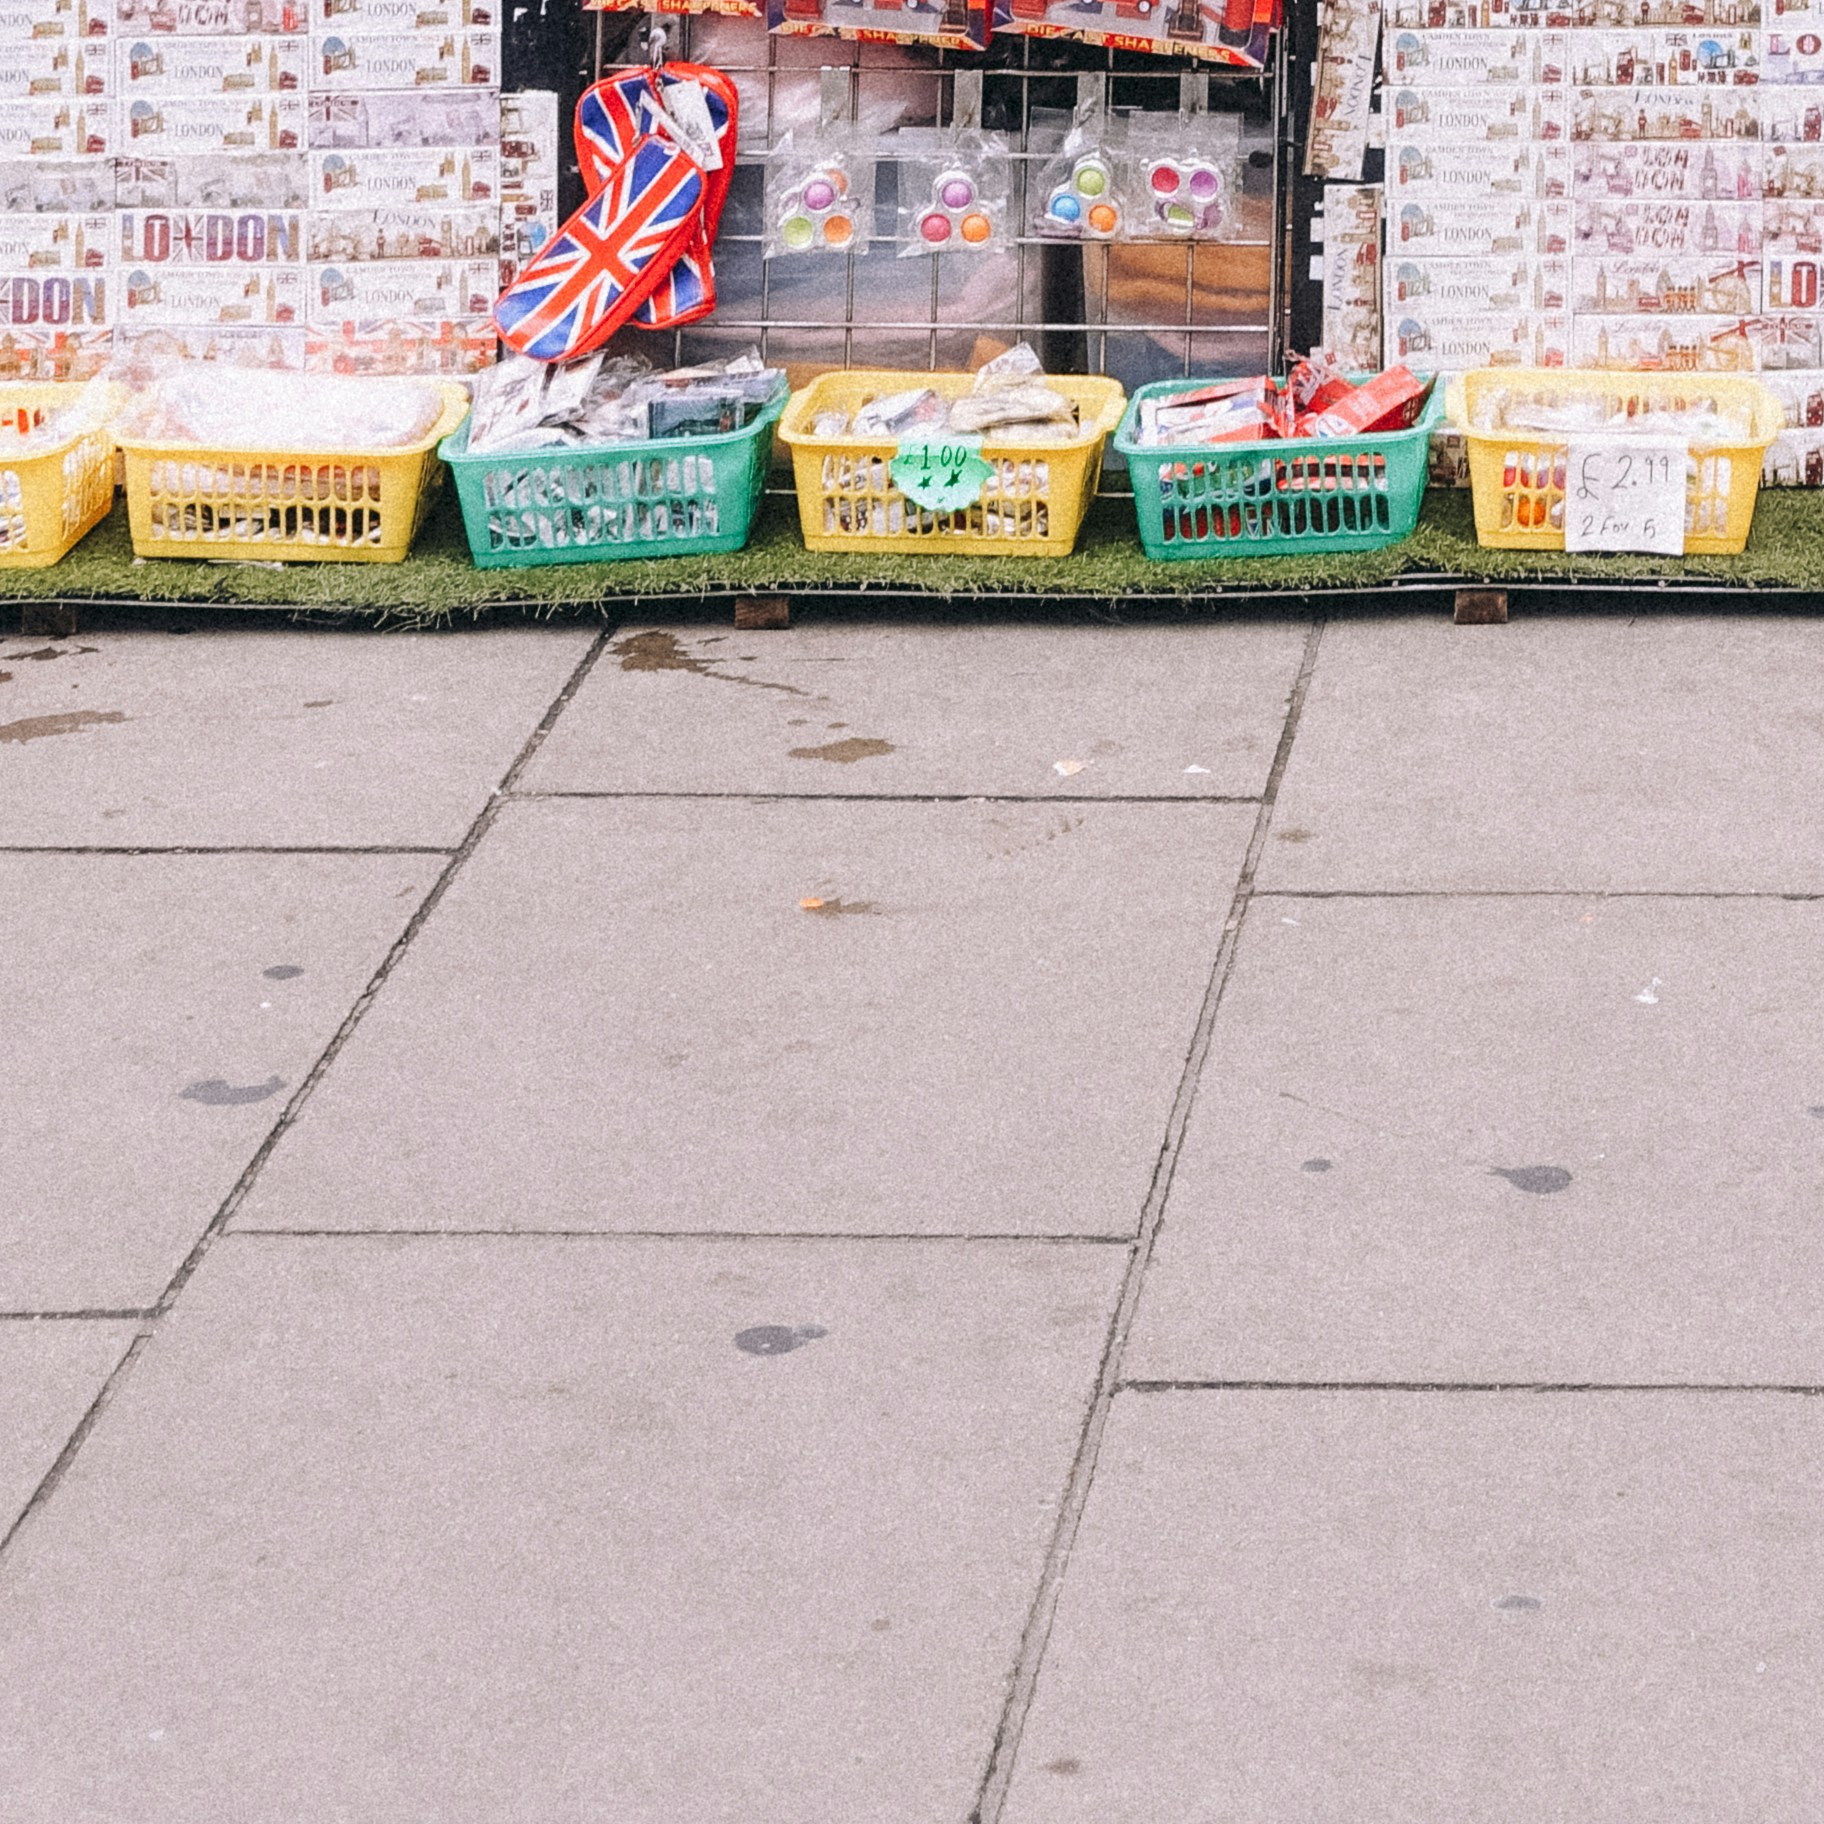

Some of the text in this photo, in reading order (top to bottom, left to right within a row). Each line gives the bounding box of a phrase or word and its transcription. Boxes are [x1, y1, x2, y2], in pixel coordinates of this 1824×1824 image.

[367, 3, 417, 16] LONDON
[366, 59, 416, 73] LONDON
[1439, 57, 1487, 70] LONDON
[174, 65, 223, 77] LONDON
[1439, 114, 1487, 127] LONDON
[174, 124, 224, 138] LONDON
[367, 175, 416, 191] LONDON
[1442, 170, 1491, 184] LONDON
[121, 213, 299, 263] LONDON
[1444, 227, 1493, 240] LONDON
[365, 289, 414, 305] LONDON
[1440, 285, 1489, 299] LONDON
[171, 294, 220, 309] LONDON
[1442, 341, 1491, 355] LONDON
[1577, 453, 1669, 500] £2.99
[1581, 515, 1594, 537] 2
